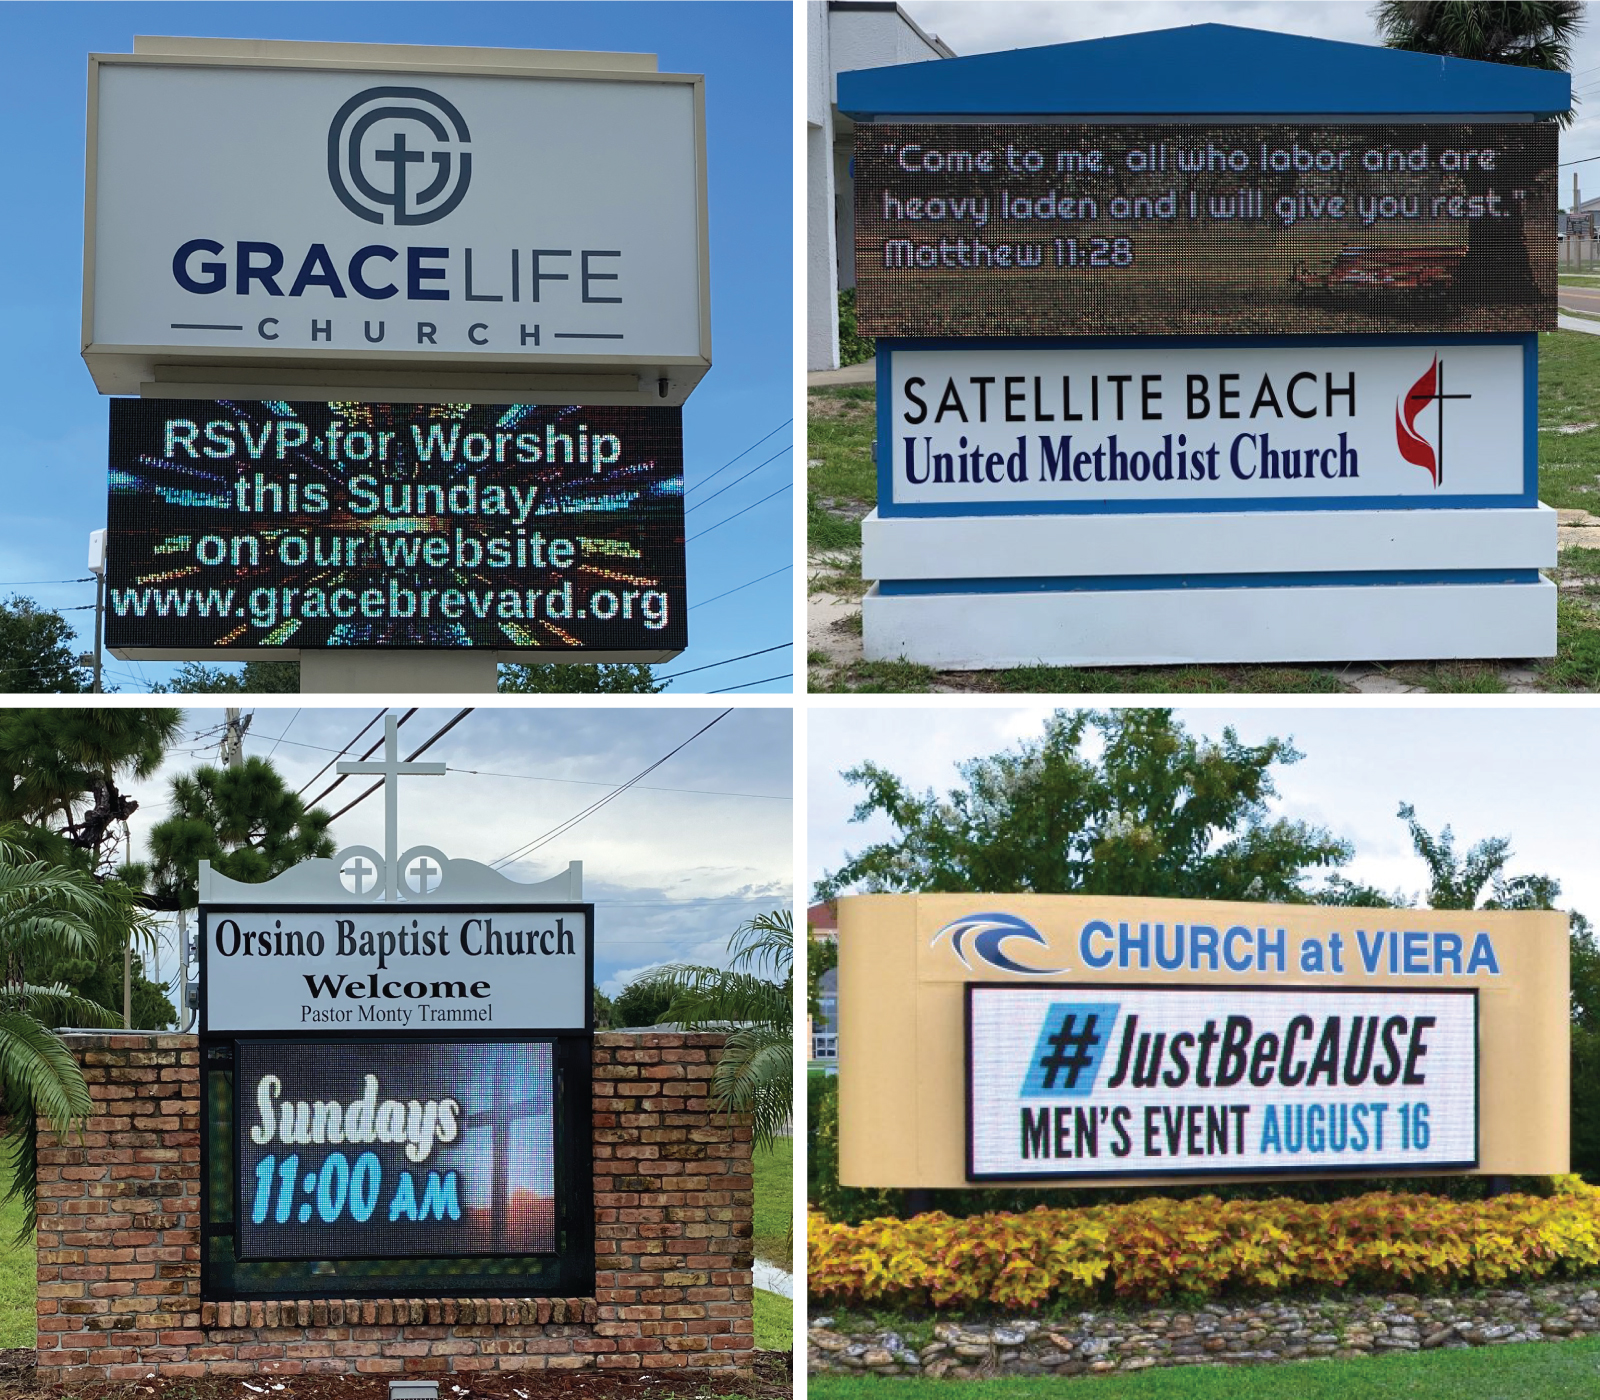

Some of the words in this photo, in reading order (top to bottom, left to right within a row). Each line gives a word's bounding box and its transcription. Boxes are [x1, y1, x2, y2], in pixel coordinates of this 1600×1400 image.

[1006, 143, 1044, 172] to
[1056, 145, 1113, 175] me,
[1127, 143, 1167, 172] all
[1177, 143, 1250, 172] who
[1258, 142, 1352, 172] labor
[1364, 141, 1429, 171] and
[1439, 144, 1496, 171] are
[882, 189, 989, 227] heavy
[1001, 188, 1099, 219] laden
[1110, 188, 1179, 219] and
[1188, 190, 1197, 218] I
[1207, 188, 1265, 218] will
[1275, 190, 1347, 226] give
[1357, 190, 1420, 225] you
[883, 236, 1043, 268] Matthew
[1053, 236, 1134, 267] 11:28
[257, 316, 541, 347] CHURCH
[902, 372, 1163, 426] SATELLITE
[1186, 370, 1357, 421] BEACH
[163, 419, 309, 461] RSVP
[325, 420, 396, 461] for
[410, 422, 623, 473] Worship
[902, 435, 1029, 485] United
[1039, 432, 1221, 482] Methodist
[1229, 430, 1360, 479] Church
[234, 474, 328, 514] this
[346, 474, 539, 526] Sunday
[195, 530, 261, 568] on
[277, 530, 363, 568] our
[381, 528, 577, 569] website
[110, 580, 670, 630] www.gracebrevard.org
[215, 918, 326, 957] Orsino
[335, 918, 451, 970] Baptist
[459, 917, 577, 956] Church
[1078, 919, 1286, 972] CHURCH
[1299, 926, 1345, 973] at
[1355, 929, 1500, 976] VIERA
[302, 973, 492, 999] Welcome
[300, 1005, 353, 1023] Pastor
[358, 1004, 413, 1026] Monty
[418, 1004, 493, 1023] Trammel
[251, 1074, 460, 1162] Sundays
[1143, 1105, 1251, 1157] EVENT
[1260, 1103, 1388, 1154] AUGUST
[1397, 1102, 1430, 1151] 16
[252, 1152, 383, 1225] 11:00
